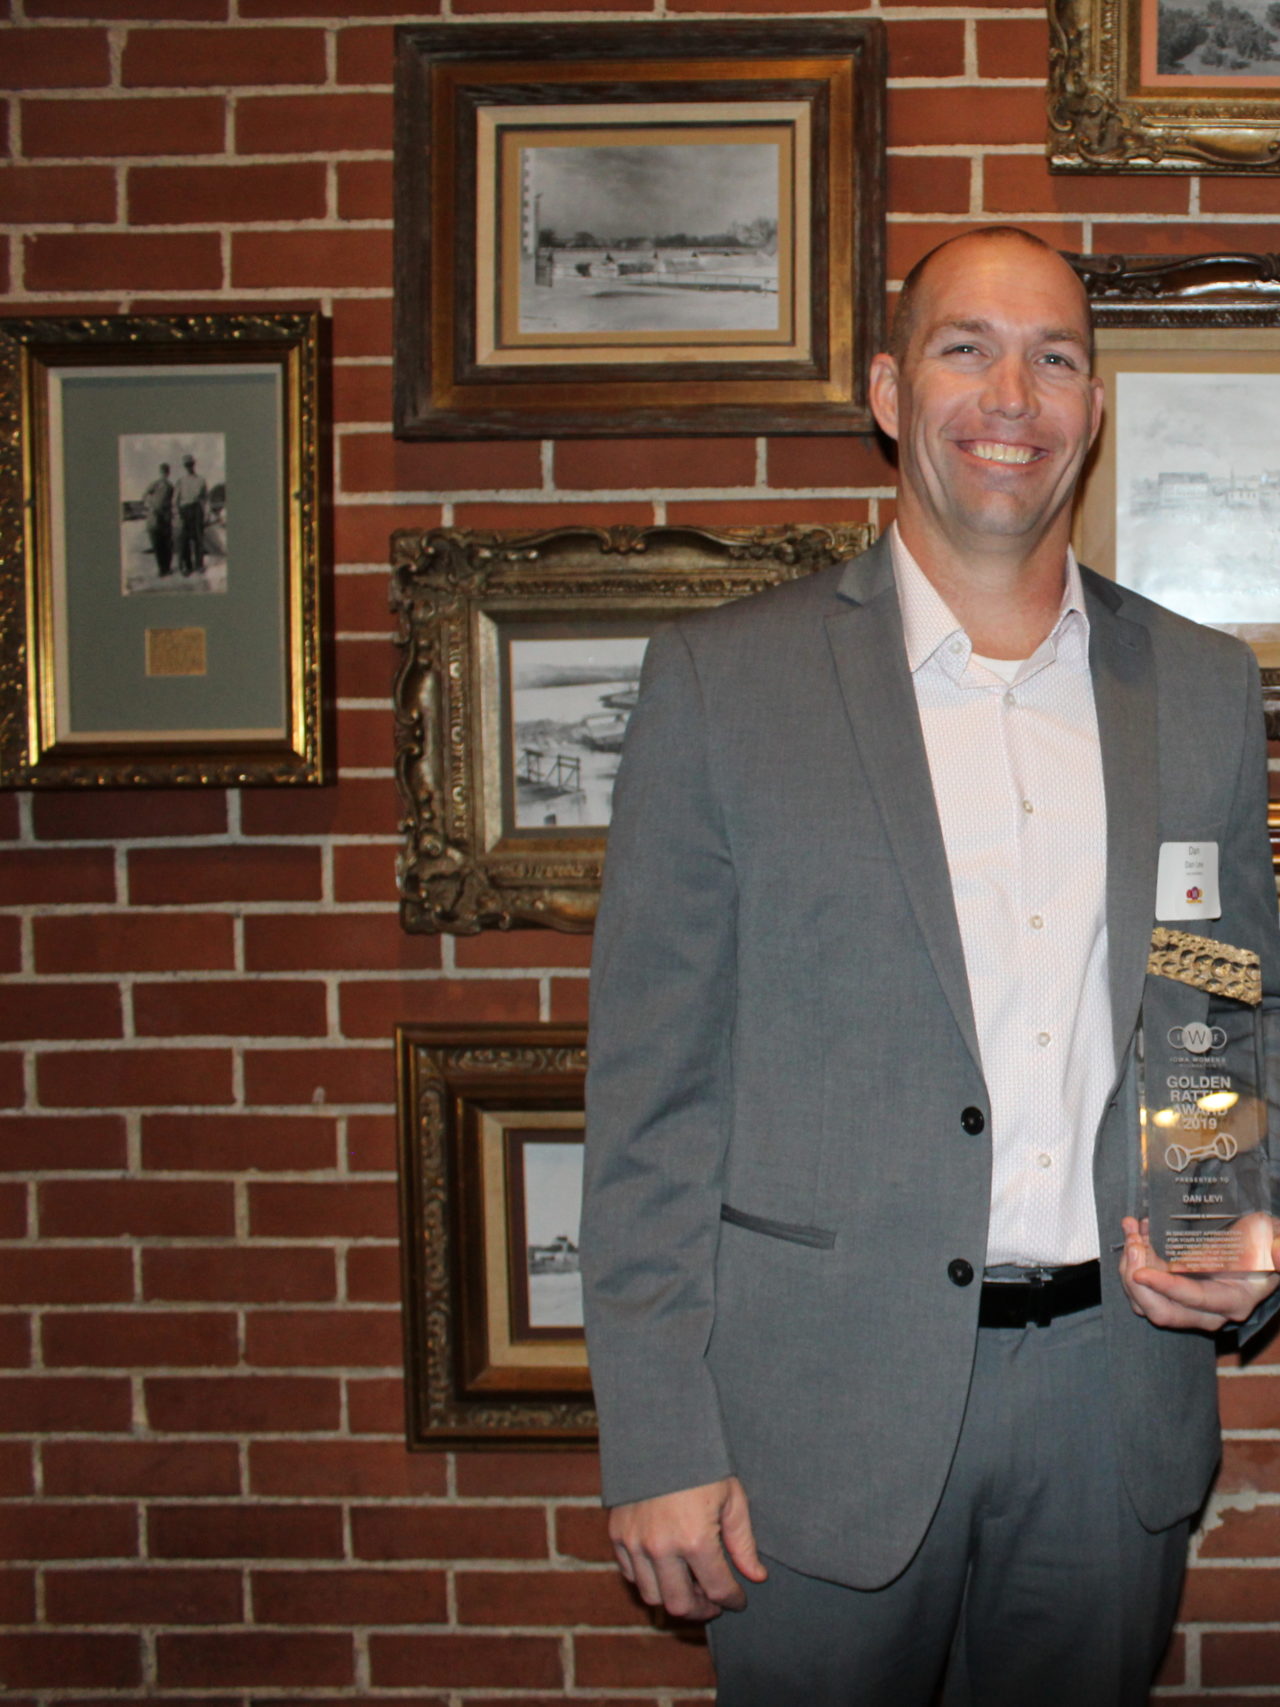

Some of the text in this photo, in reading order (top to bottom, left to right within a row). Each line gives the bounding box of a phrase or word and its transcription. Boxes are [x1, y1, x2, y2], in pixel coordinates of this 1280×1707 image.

[1166, 1075, 1232, 1089] GOLDEN
[1183, 1117, 1218, 1130] 2019
[1182, 1194, 1223, 1203] DAN LEVI
